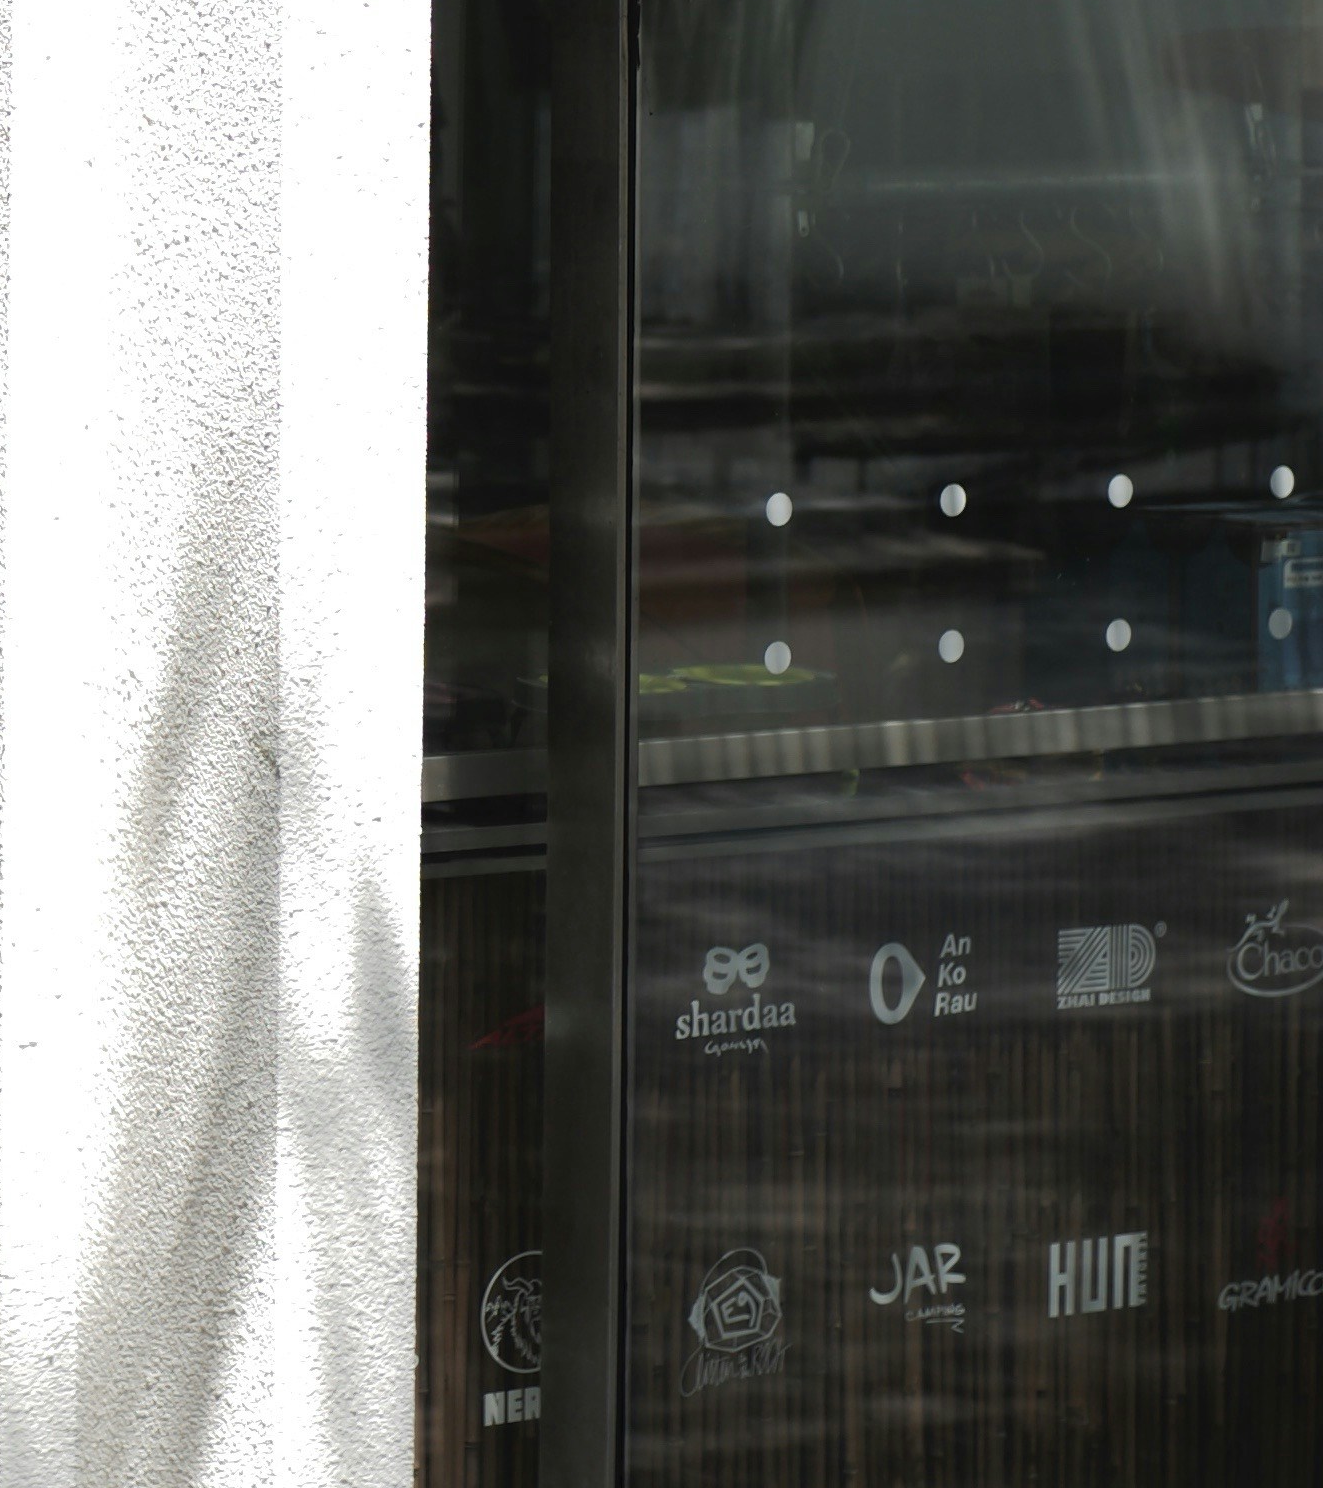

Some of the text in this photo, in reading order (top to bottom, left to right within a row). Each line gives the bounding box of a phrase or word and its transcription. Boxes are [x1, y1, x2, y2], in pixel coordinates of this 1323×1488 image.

[939, 932, 972, 959] An
[937, 961, 967, 988] Ko
[675, 992, 797, 1040] shardaa
[933, 990, 978, 1017] Rau
[869, 1242, 967, 1306] JAR
